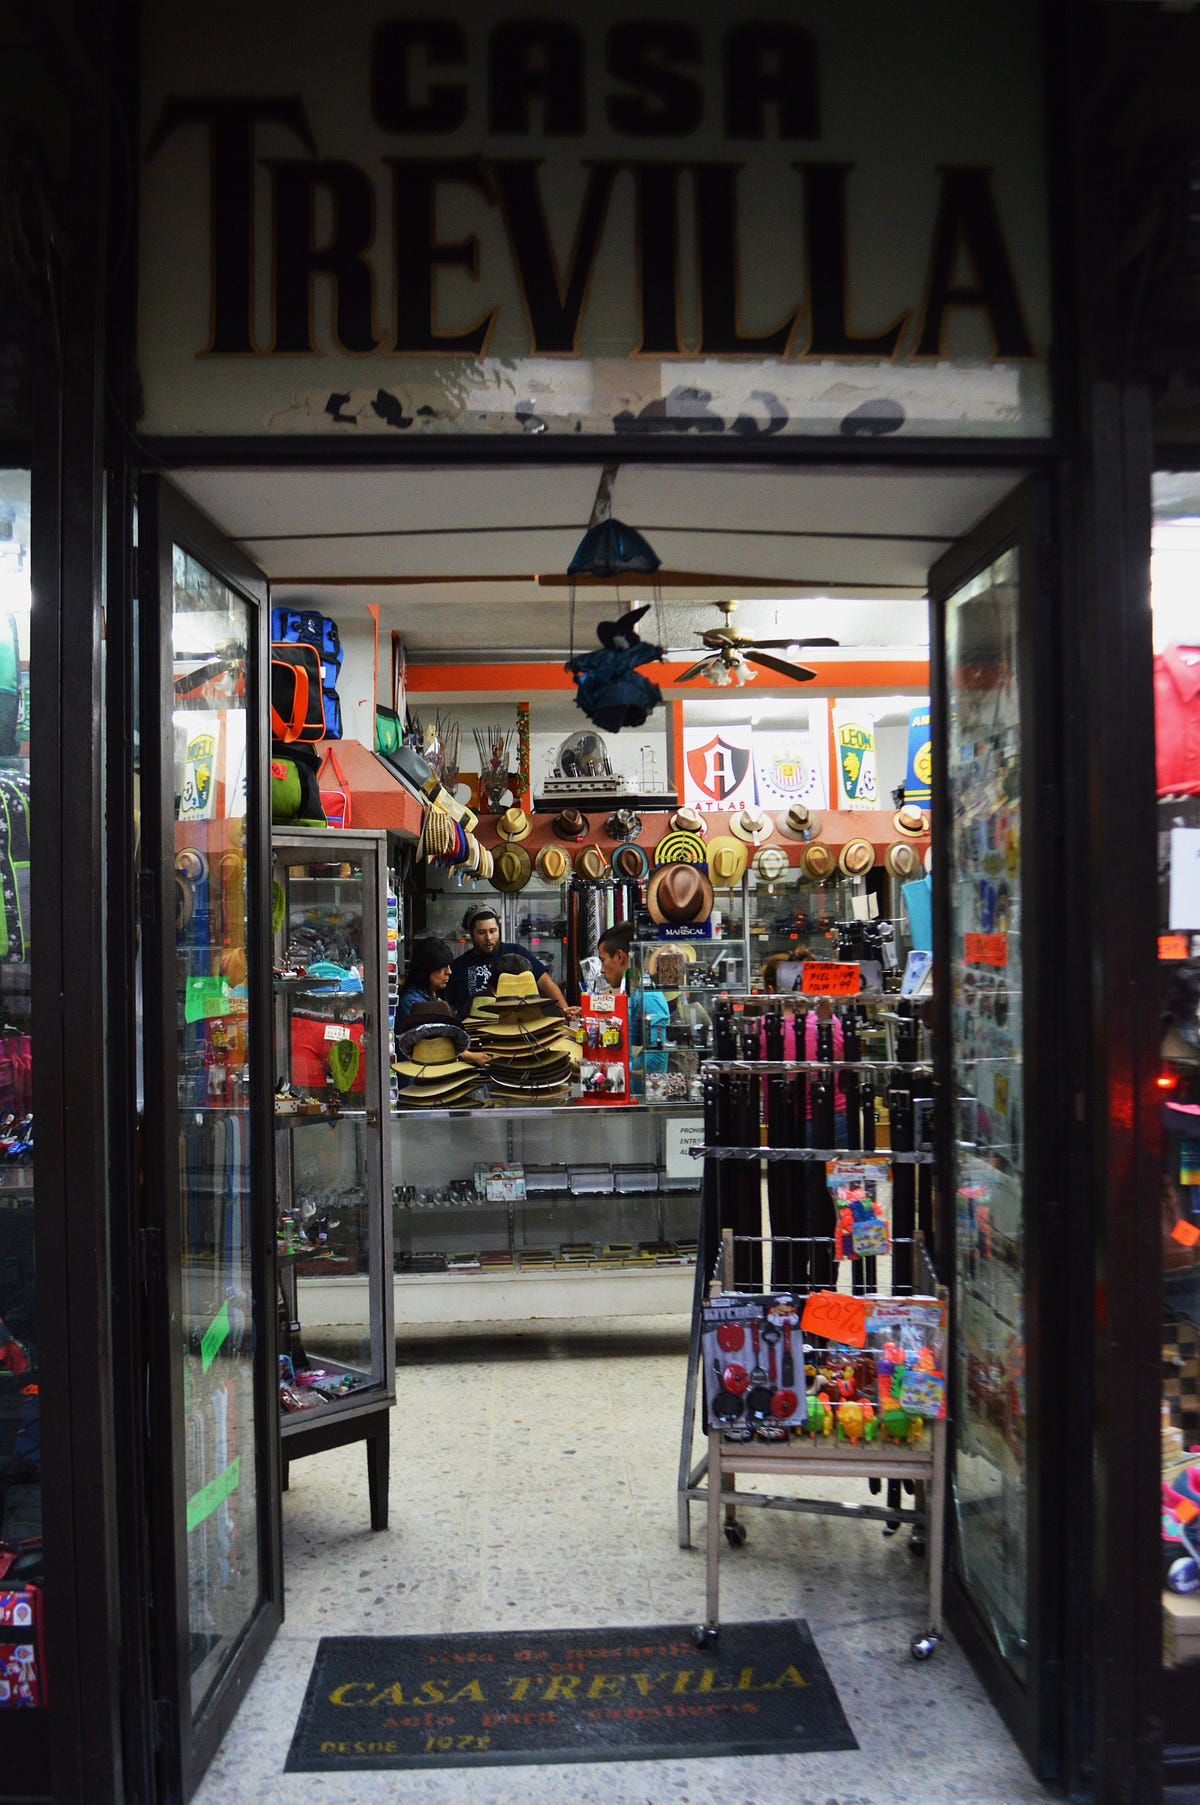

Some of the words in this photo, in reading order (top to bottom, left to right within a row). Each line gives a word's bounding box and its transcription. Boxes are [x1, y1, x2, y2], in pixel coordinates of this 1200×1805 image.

[370, 16, 822, 141] CASA
[144, 95, 1046, 361] TREVILLA
[694, 800, 746, 812] ATLAS
[665, 928, 706, 936] MARISCAL
[328, 1679, 486, 1707] CASA
[504, 1664, 812, 1702] TREVILLA
[320, 1740, 398, 1753] DESDE
